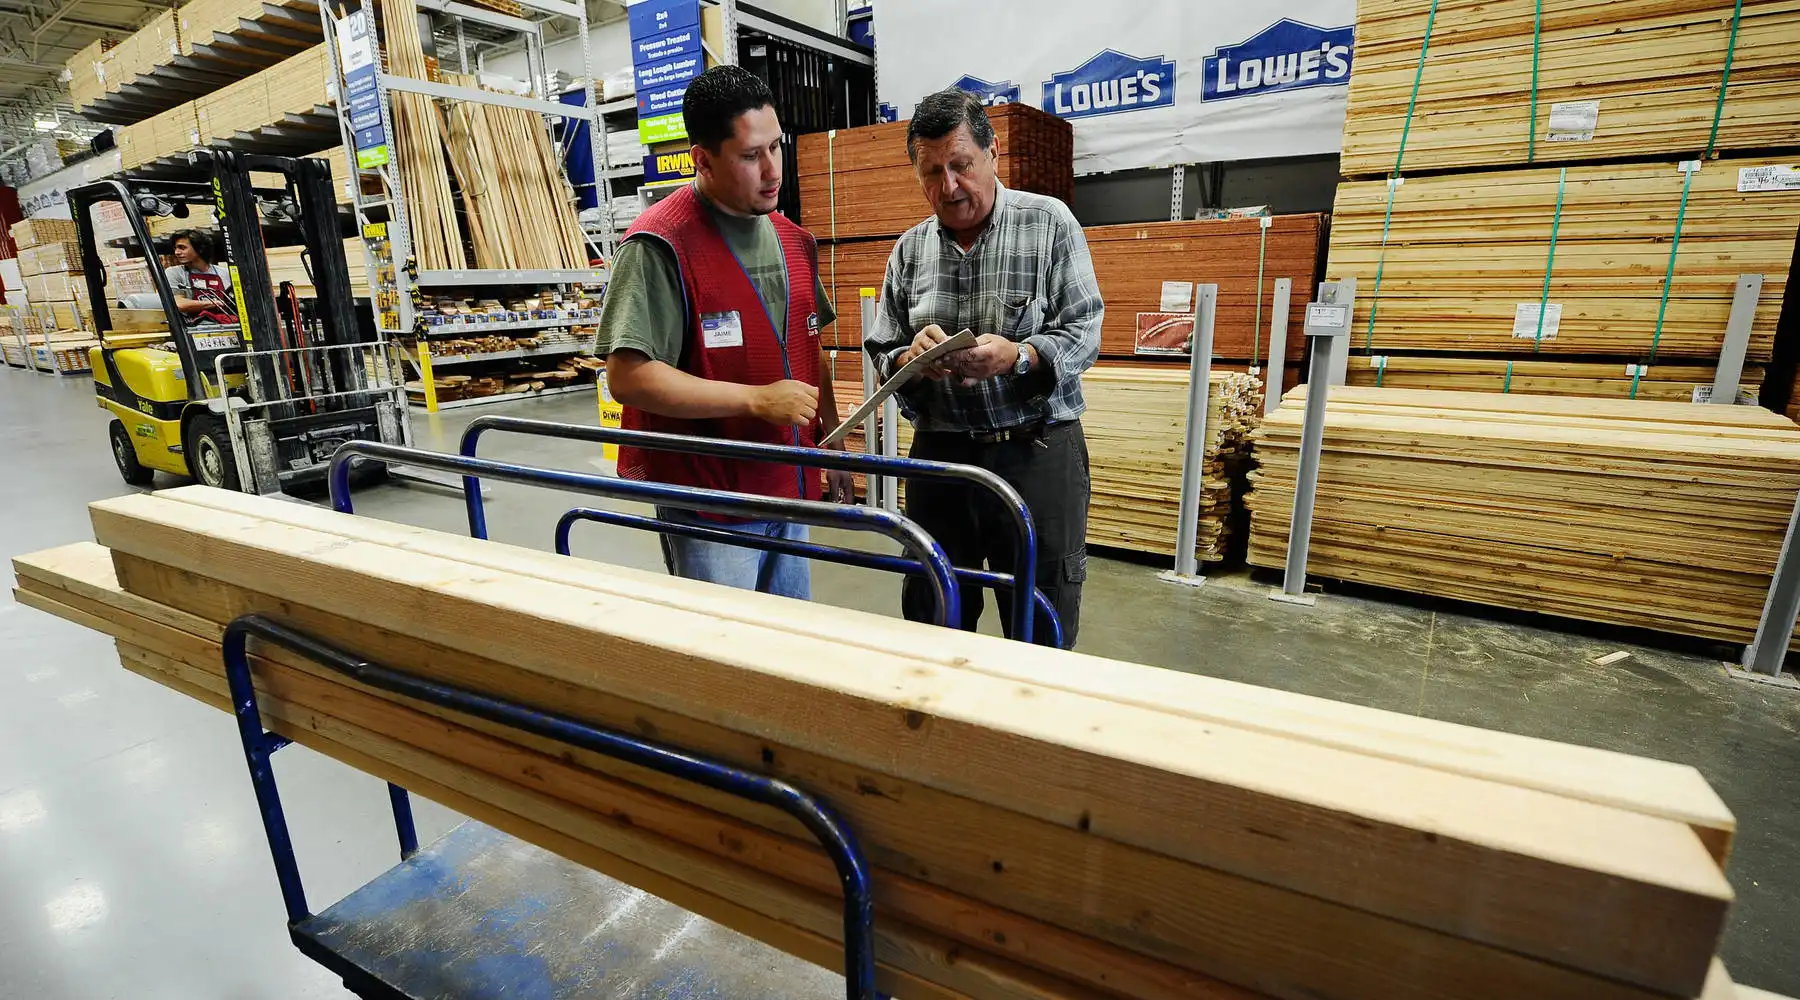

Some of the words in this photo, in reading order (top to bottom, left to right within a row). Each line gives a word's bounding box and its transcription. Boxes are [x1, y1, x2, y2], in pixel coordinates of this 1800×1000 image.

[350, 12, 366, 38] 20
[640, 40, 666, 53] Pressure
[666, 32, 691, 46] Treated
[638, 68, 653, 78] Long
[652, 63, 673, 74] Length
[673, 59, 696, 70] Lumber
[1217, 41, 1350, 93] LOWE'S
[650, 91, 666, 102] Wood
[1054, 69, 1161, 114] LOWE'S
[657, 153, 695, 171] IRWIN
[213, 176, 226, 220] Yale
[138, 400, 153, 415] Yale
